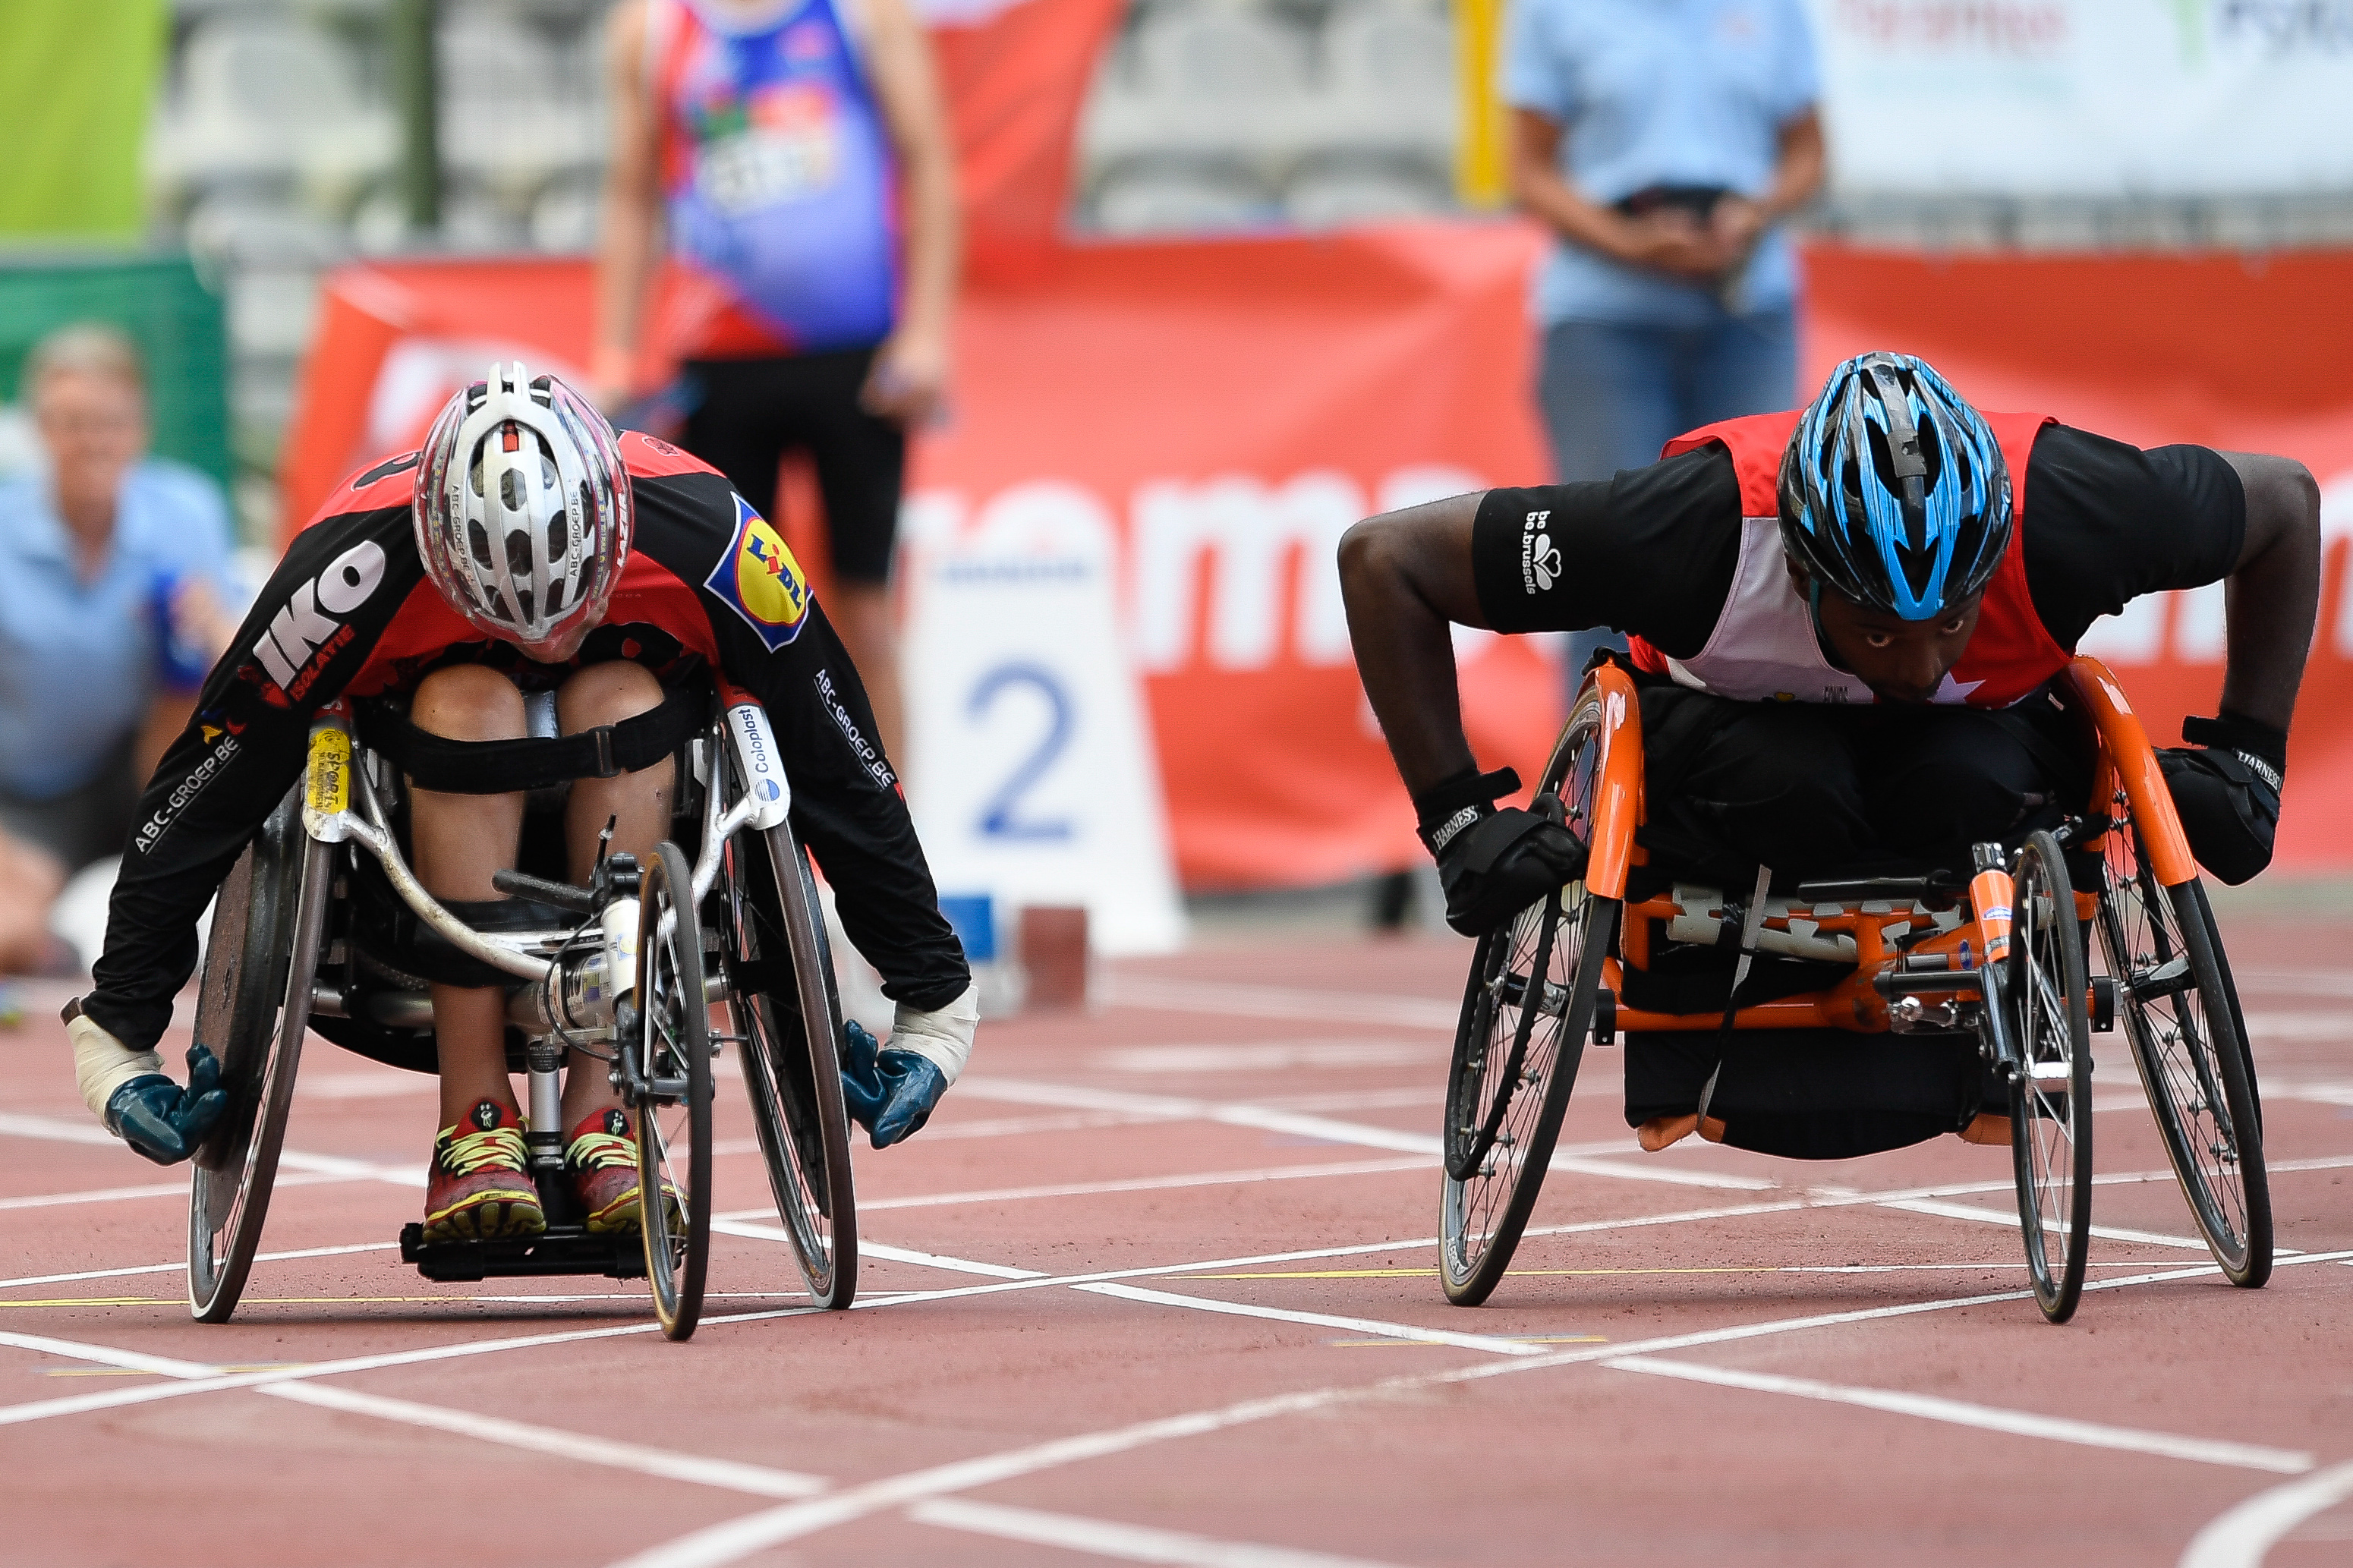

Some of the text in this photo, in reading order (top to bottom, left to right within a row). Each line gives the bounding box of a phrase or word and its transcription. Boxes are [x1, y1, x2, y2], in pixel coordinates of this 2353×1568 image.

[1522, 512, 1539, 595] be.brussels
[251, 539, 386, 691] IKO
[737, 708, 769, 773] Coloplast
[814, 668, 895, 788] ABC-GROEP.BE
[964, 656, 1078, 842] 2
[134, 735, 239, 853] ABC-GROEP.BE
[1432, 804, 1479, 851] HARNESS
